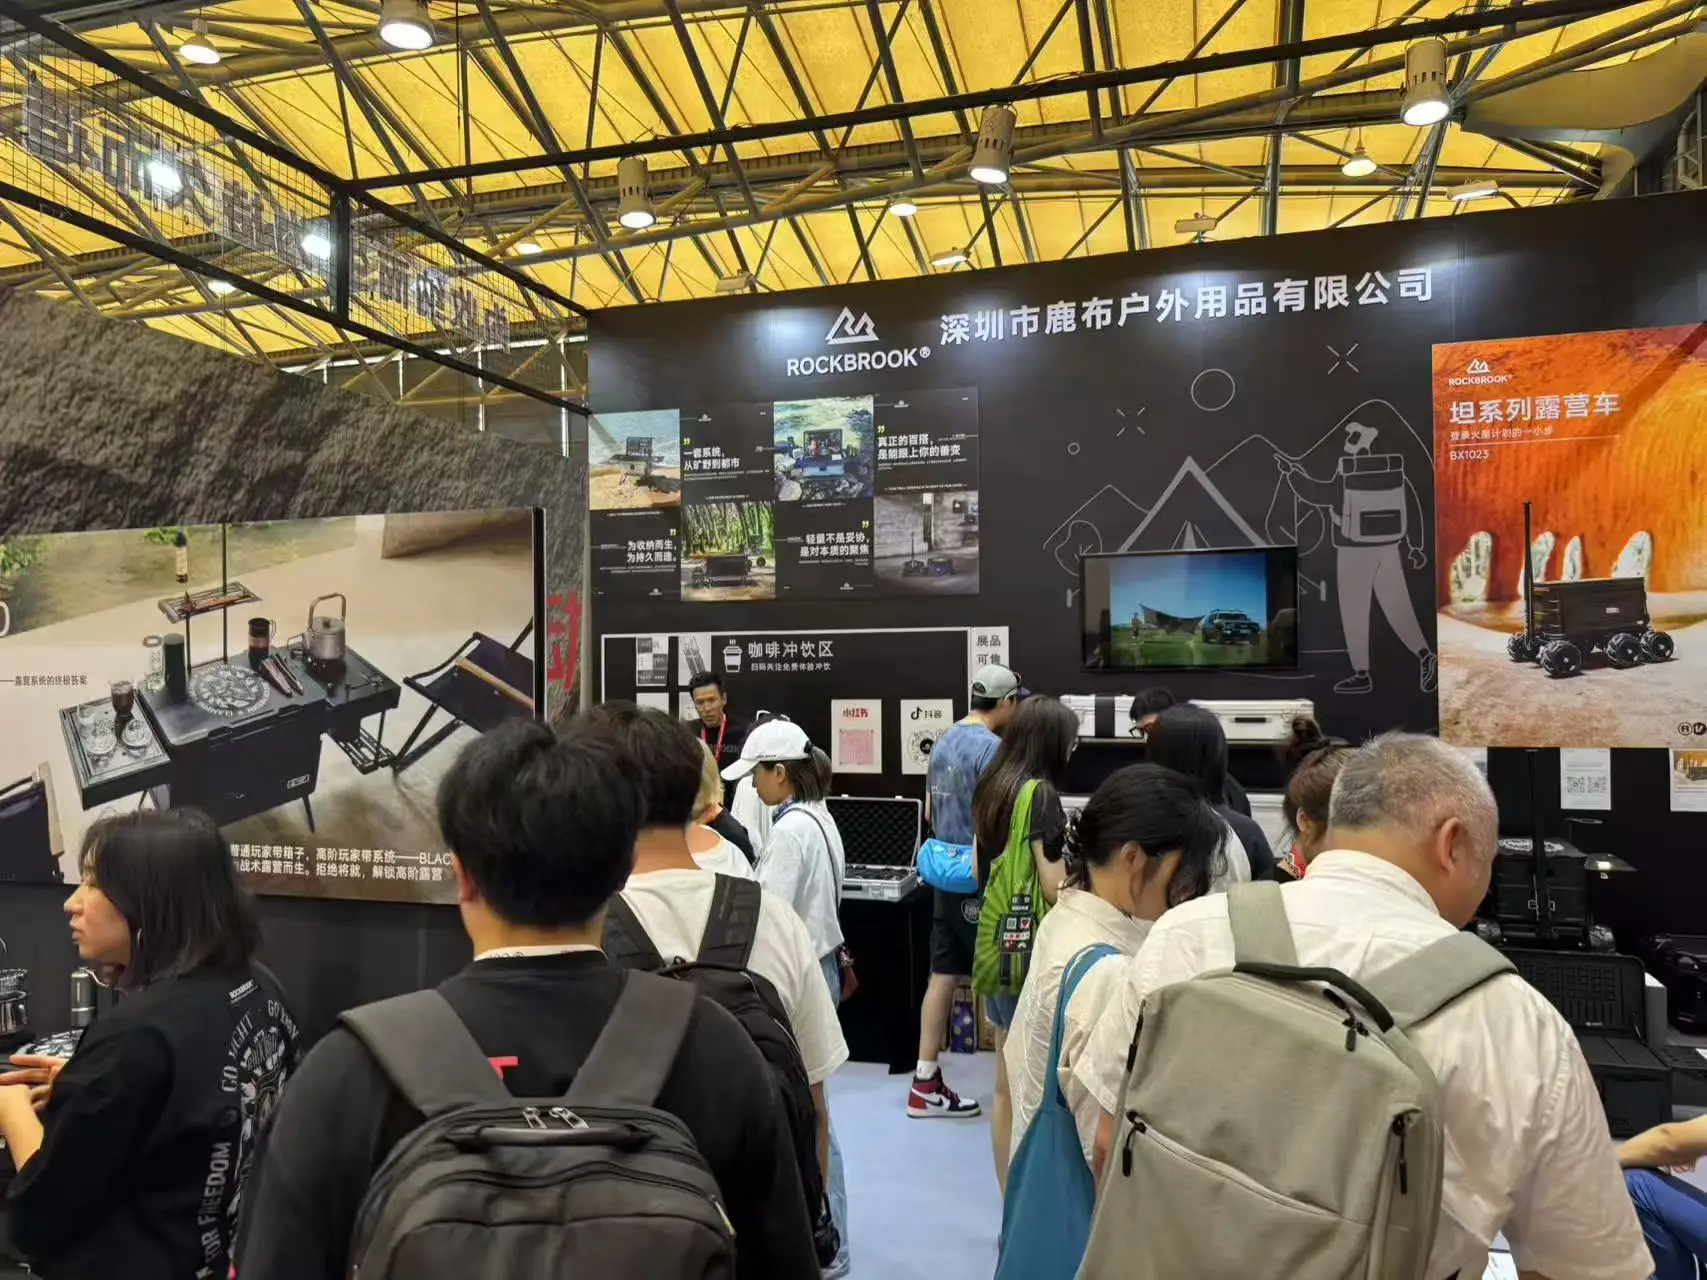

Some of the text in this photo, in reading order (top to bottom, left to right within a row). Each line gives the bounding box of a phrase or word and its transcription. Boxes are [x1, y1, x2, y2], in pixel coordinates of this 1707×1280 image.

[939, 268, 1433, 346] 深圳市鹿布户外用品有限公司
[1449, 392, 1621, 425] 坦系列露营车
[1450, 449, 1489, 461] BX1023
[976, 635, 1001, 647] 展品
[748, 640, 834, 658] 咖啡冲饮区
[751, 662, 832, 672] 扫码关注免费体验冲饮
[843, 707, 869, 718] 小红书
[924, 709, 943, 719] 抖音
[222, 1065, 238, 1092] GO
